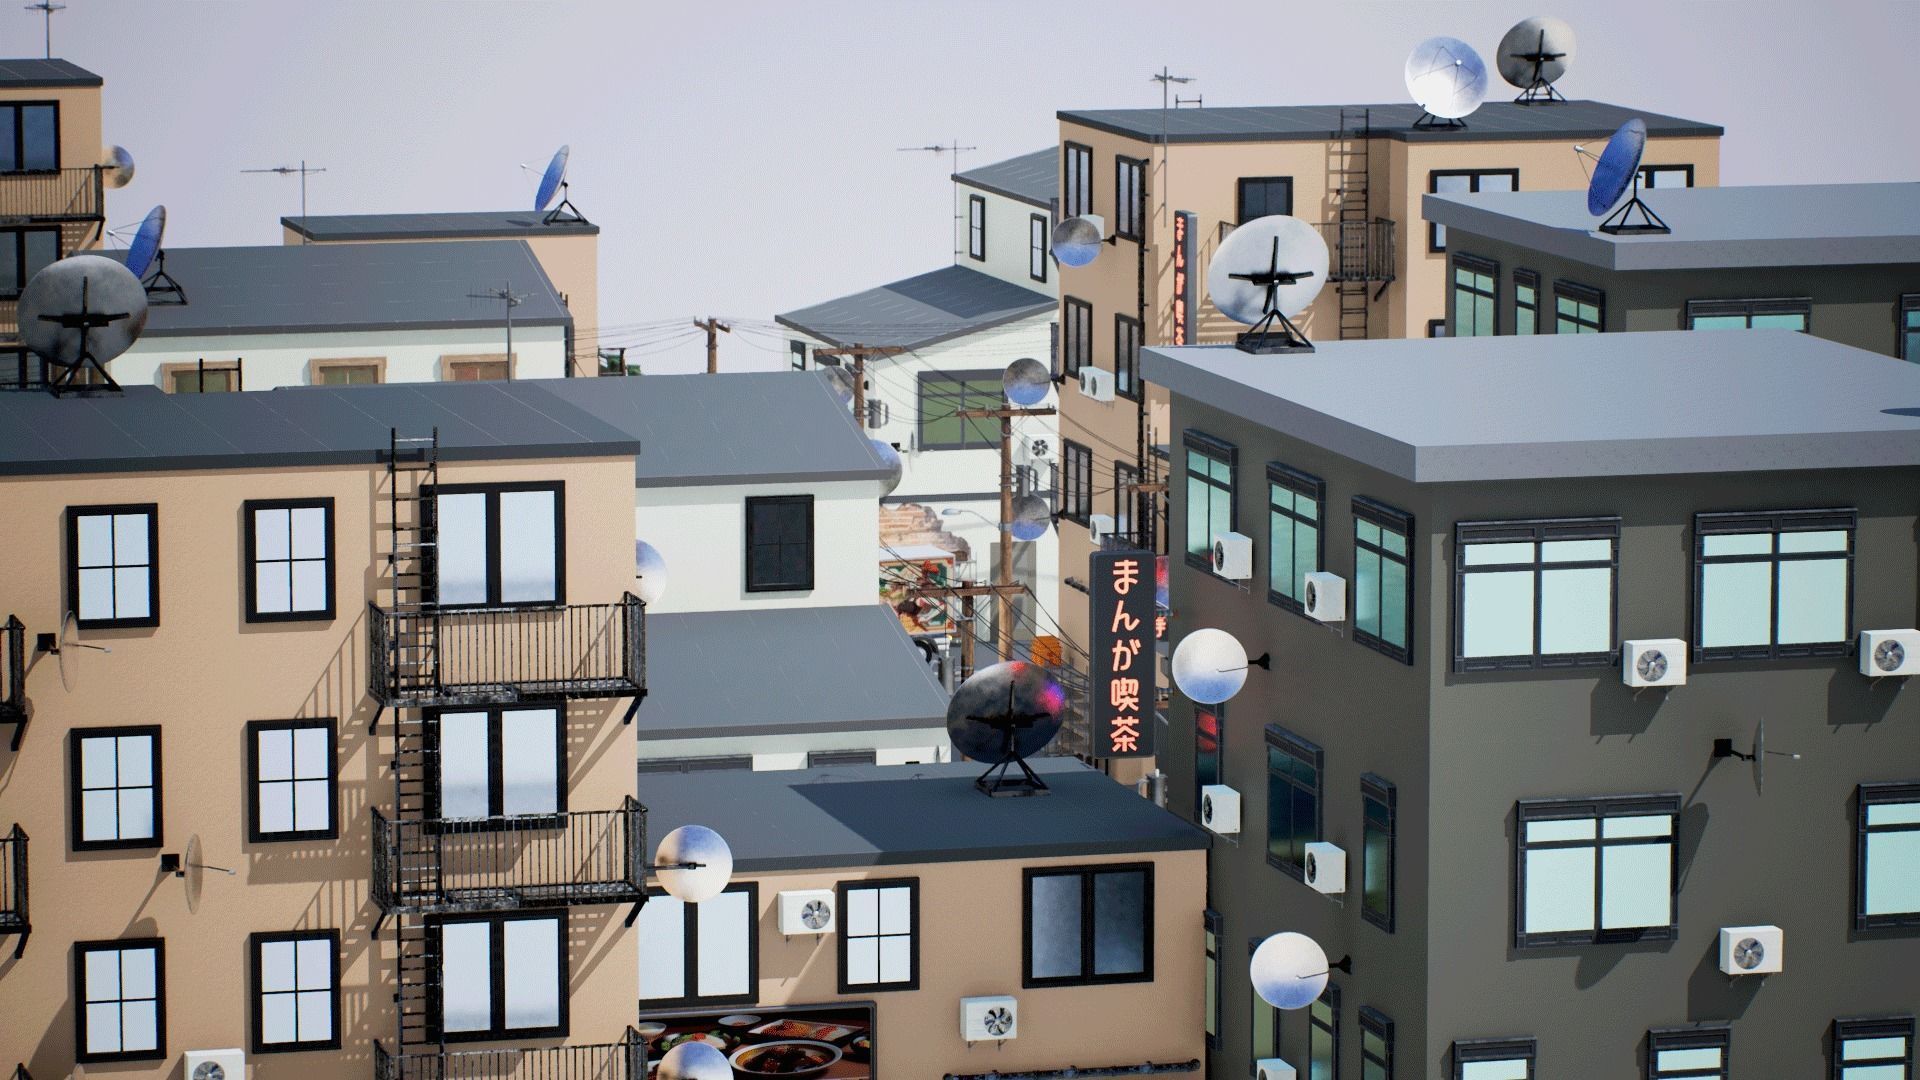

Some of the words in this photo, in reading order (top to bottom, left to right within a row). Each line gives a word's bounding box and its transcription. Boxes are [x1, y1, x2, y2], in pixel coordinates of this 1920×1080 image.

[1111, 560, 1141, 752] まんが喫茶
